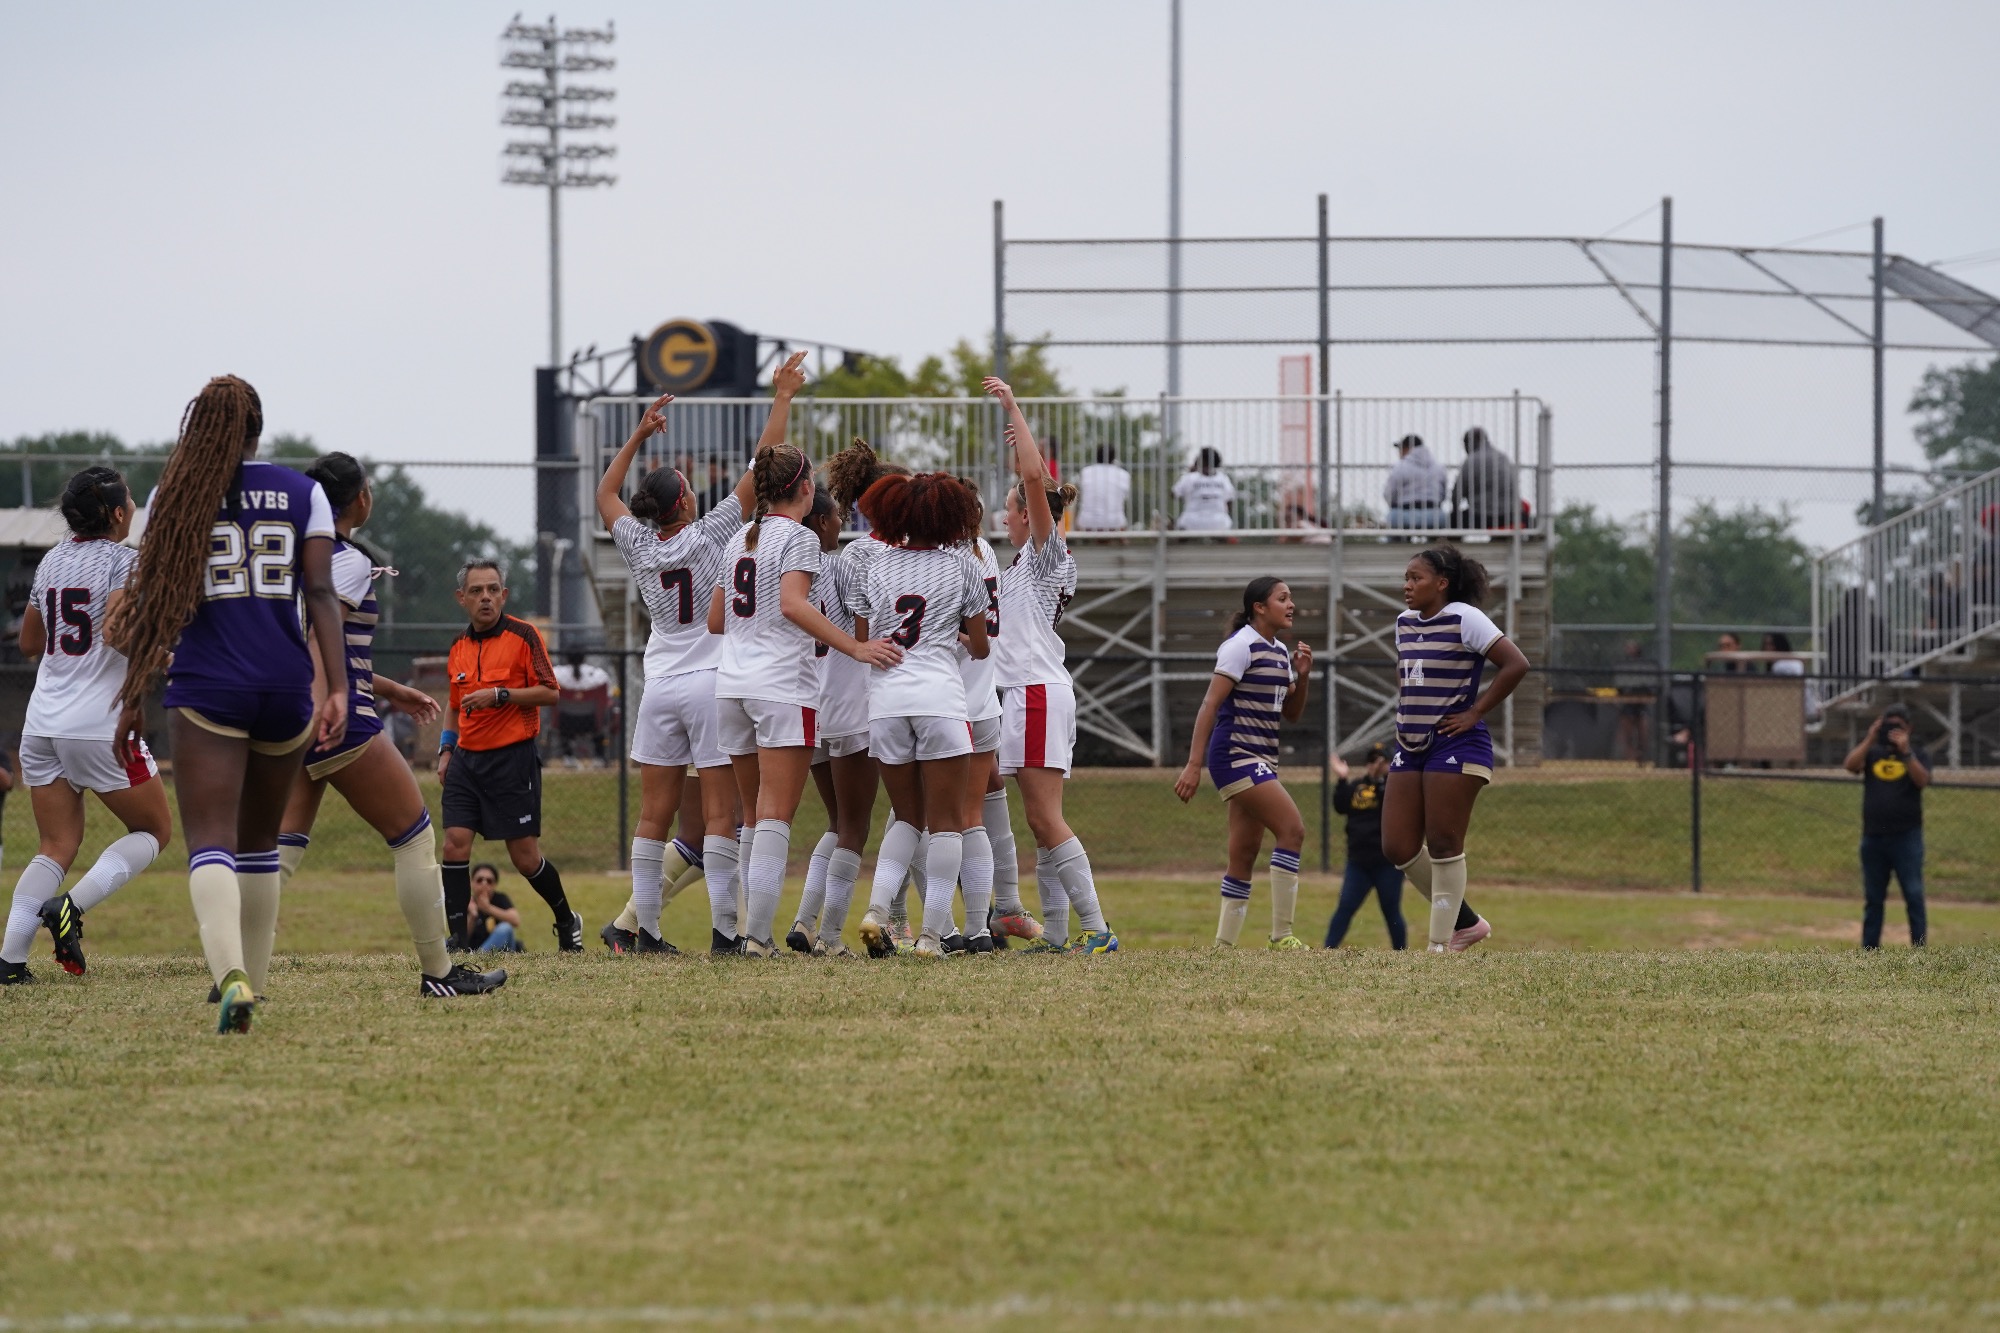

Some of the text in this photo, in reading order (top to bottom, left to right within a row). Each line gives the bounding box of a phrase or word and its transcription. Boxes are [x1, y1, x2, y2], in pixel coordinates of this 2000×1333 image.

[647, 326, 709, 386] G
[221, 490, 289, 510] AVES
[204, 520, 297, 601] 22
[732, 557, 757, 618] 9
[46, 587, 93, 656] 15
[660, 567, 694, 624] 7
[891, 594, 927, 651] 3
[1403, 658, 1425, 686] 14
